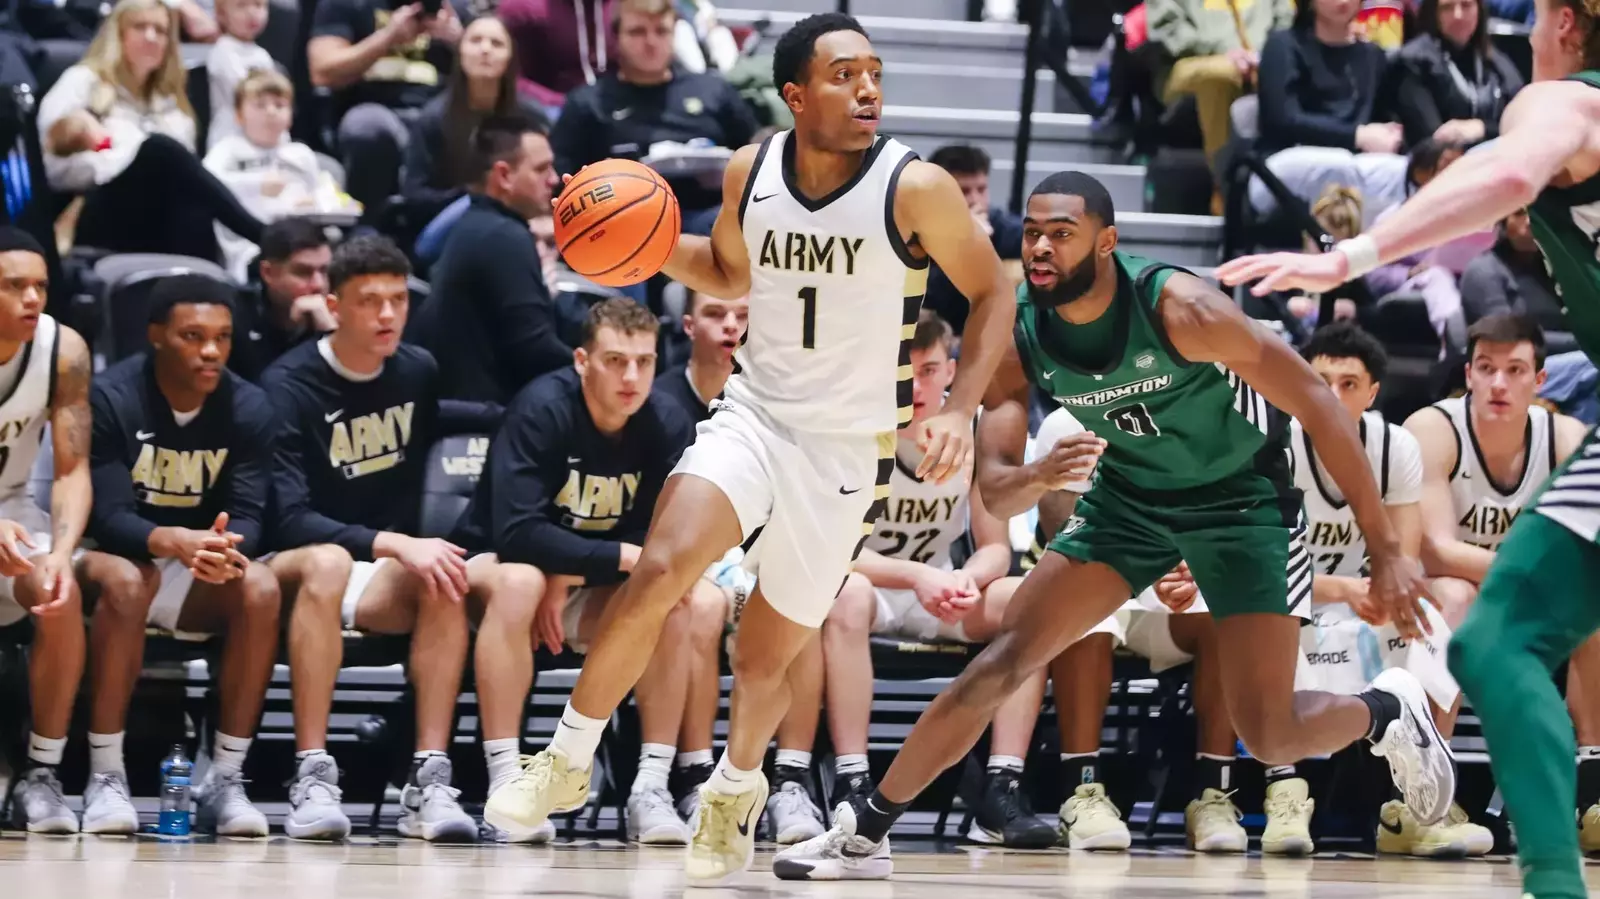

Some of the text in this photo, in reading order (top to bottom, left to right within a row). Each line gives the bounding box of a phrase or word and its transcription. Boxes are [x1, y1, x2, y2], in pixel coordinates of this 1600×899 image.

[759, 229, 864, 275] ARMY
[798, 286, 817, 349] 1
[1060, 375, 1168, 405] INGHAMTON
[329, 401, 415, 468] ARMY
[131, 442, 229, 494] ARMY
[553, 469, 642, 518] ARMY
[1301, 520, 1363, 546] RM
[1459, 503, 1521, 535] ARM
